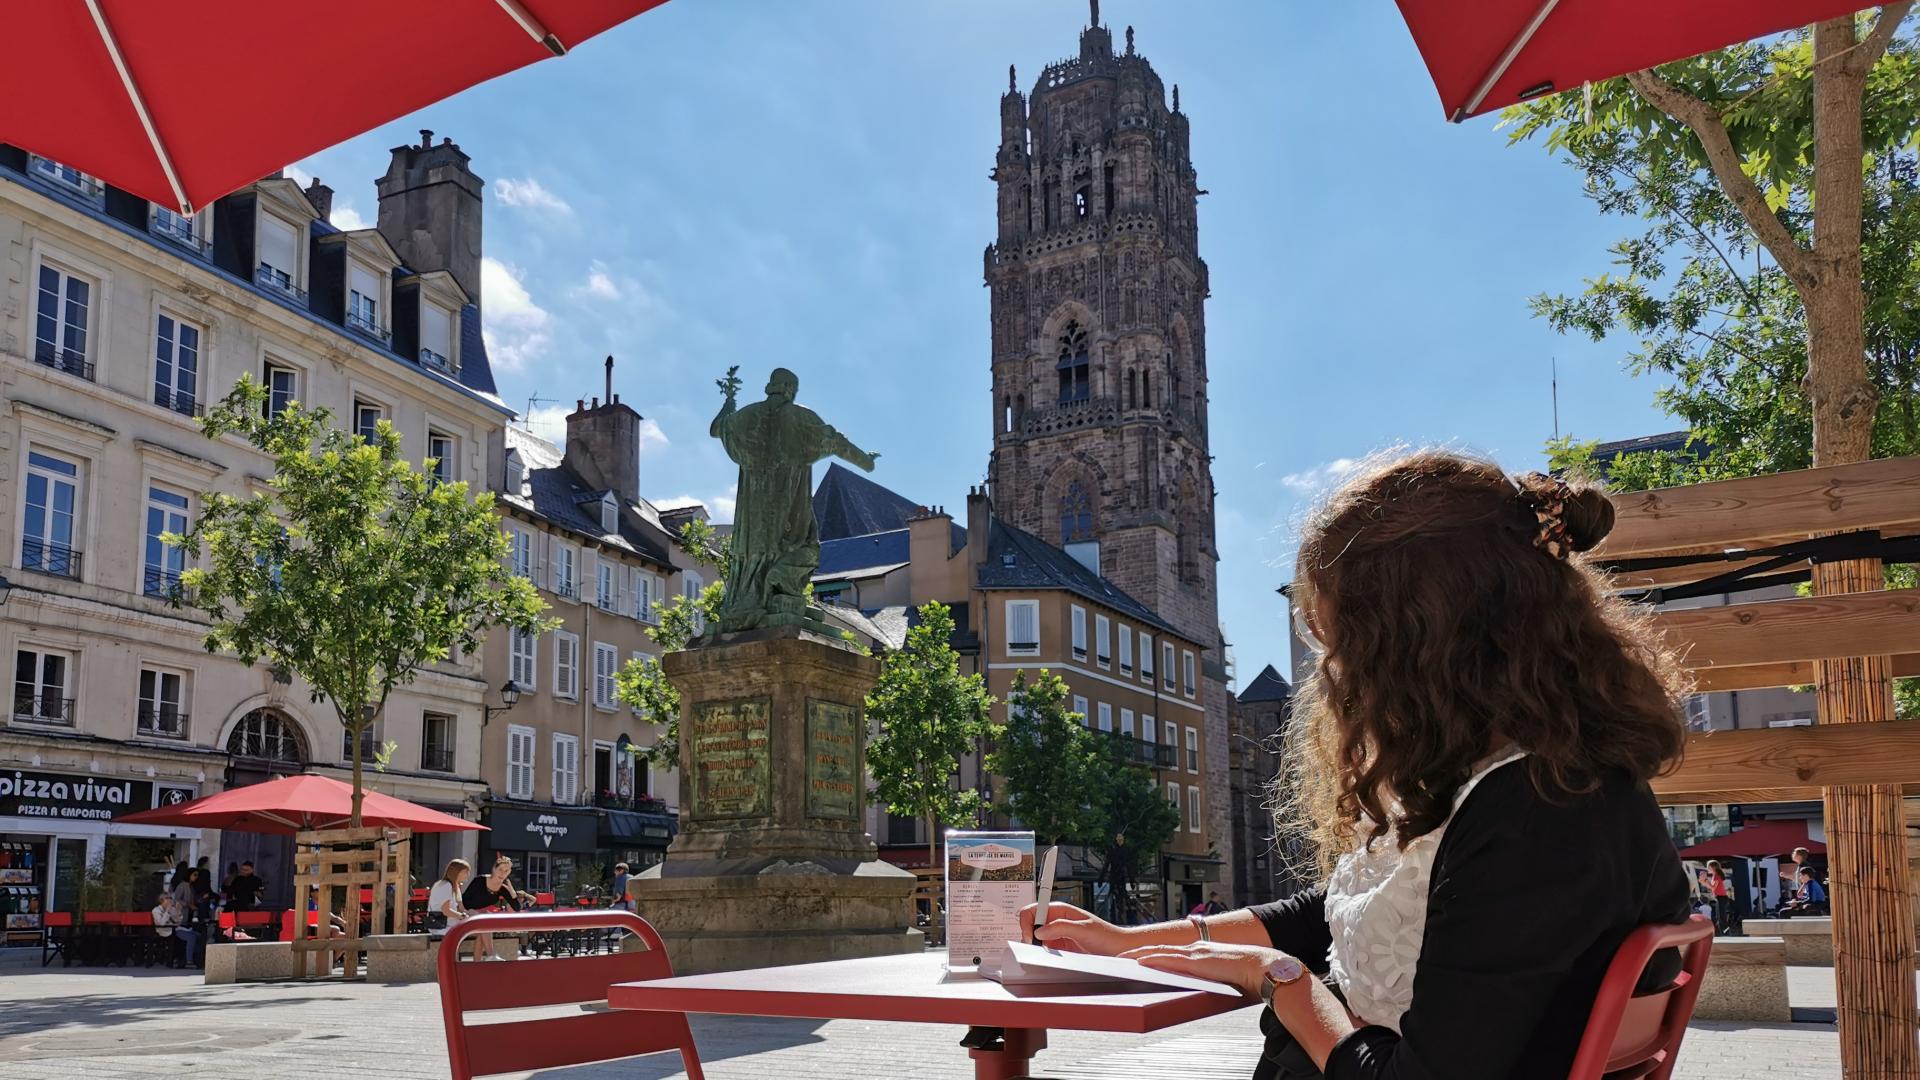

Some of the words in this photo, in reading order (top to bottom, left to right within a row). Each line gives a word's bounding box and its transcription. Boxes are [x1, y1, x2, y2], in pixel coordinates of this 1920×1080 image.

[0, 771, 68, 799] pizza
[73, 778, 131, 804] vival
[18, 805, 48, 816] PIZZA
[61, 807, 112, 819] EMPORTER
[526, 821, 544, 836] chez
[544, 825, 568, 837] margo
